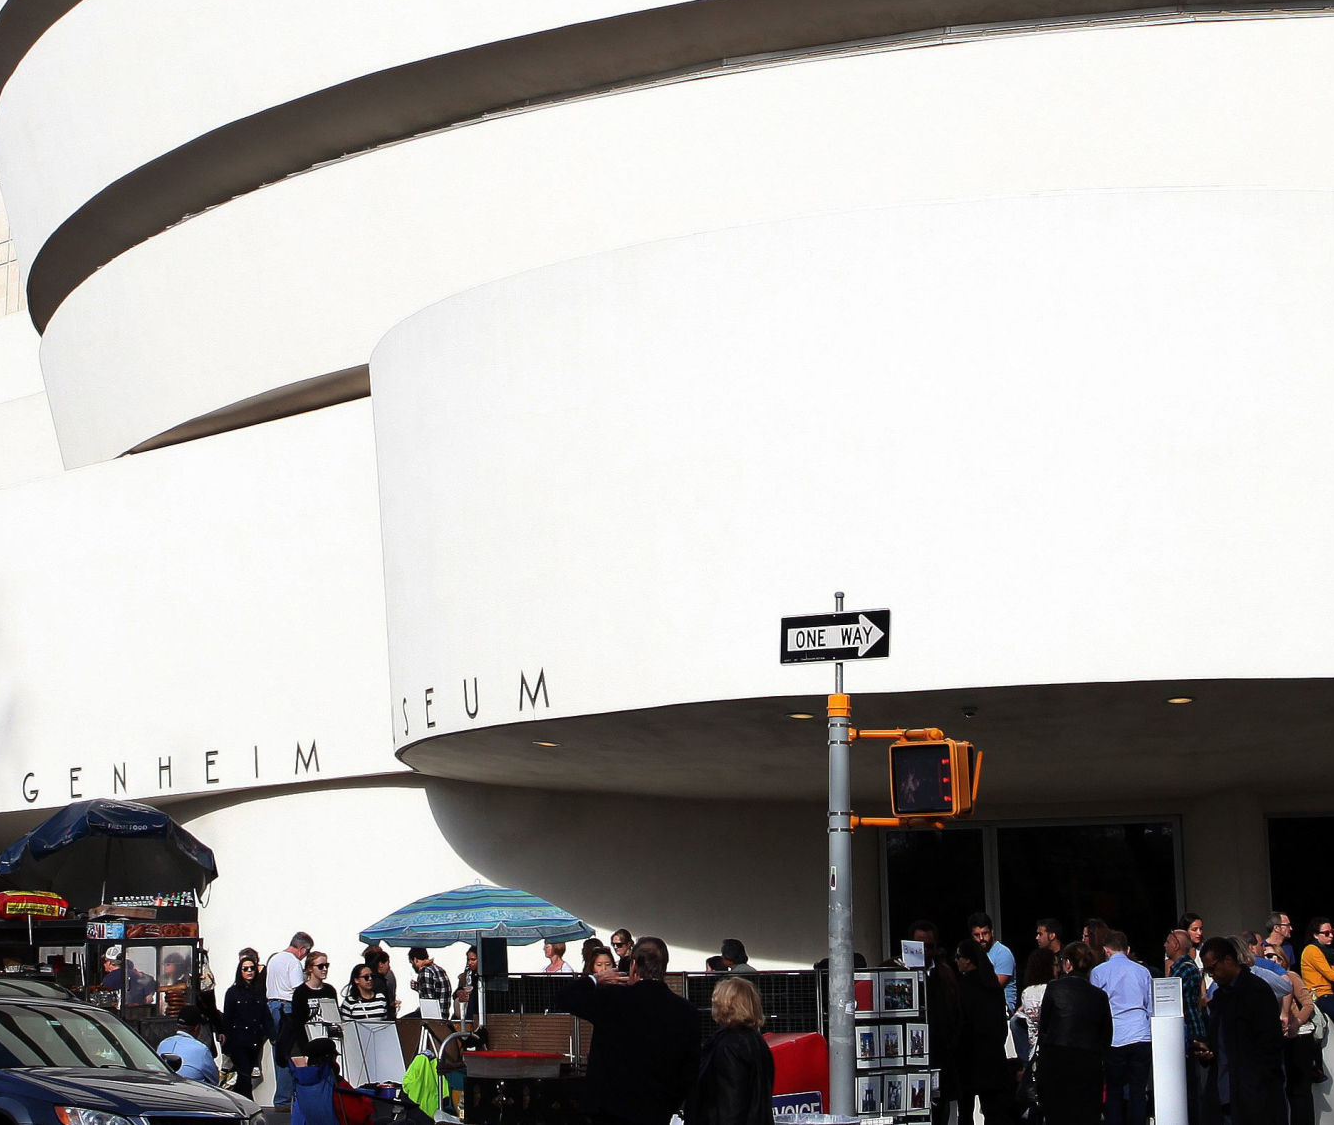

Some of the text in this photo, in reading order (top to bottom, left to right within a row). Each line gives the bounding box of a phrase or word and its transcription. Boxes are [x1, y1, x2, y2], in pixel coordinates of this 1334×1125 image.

[796, 626, 873, 649] ONE WAY
[392, 667, 550, 745] SEUM
